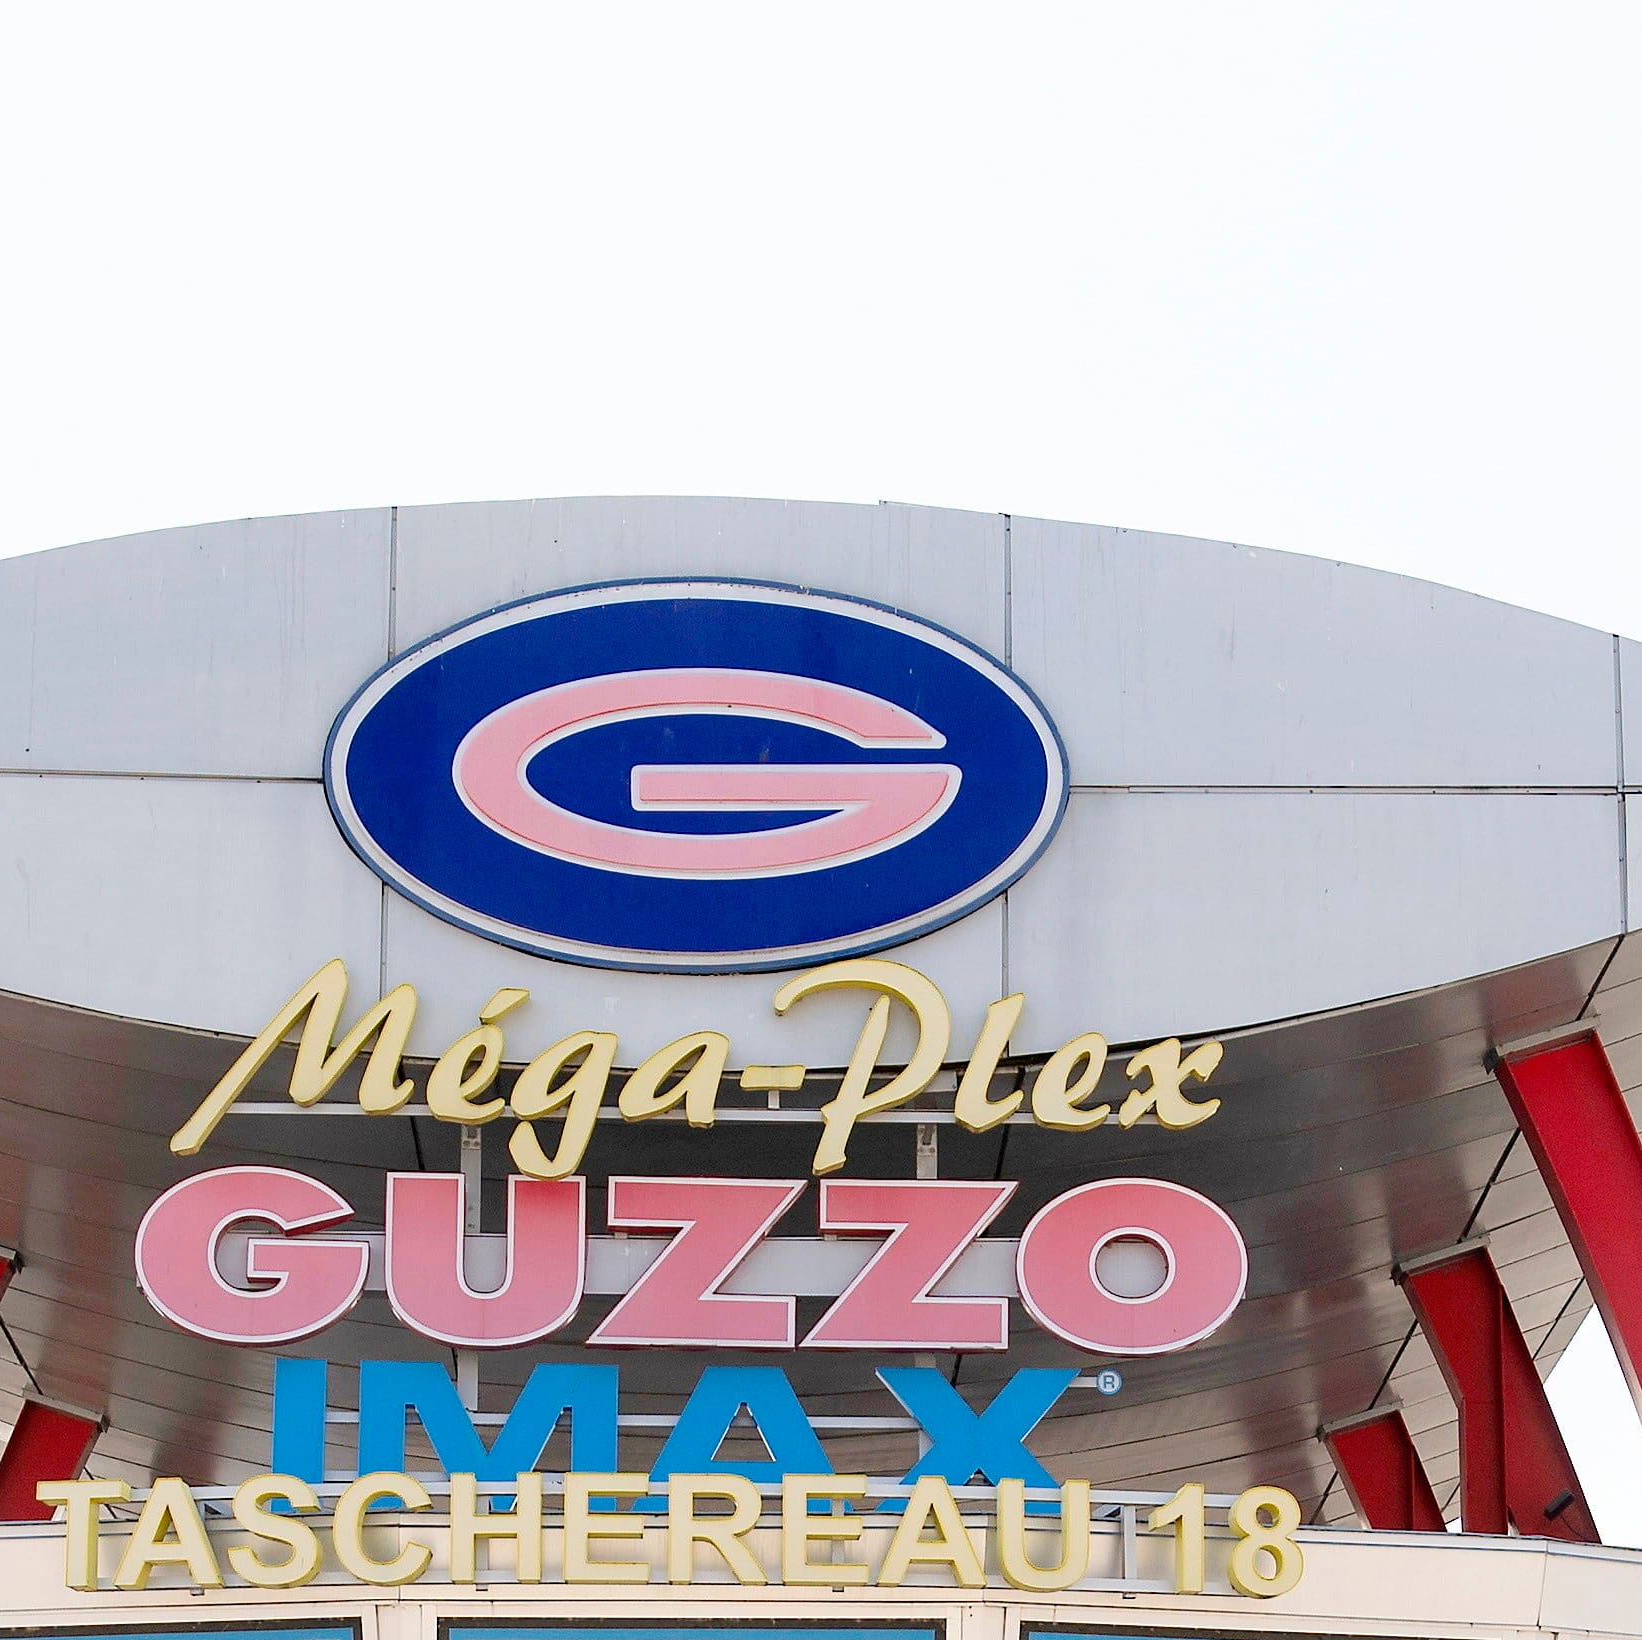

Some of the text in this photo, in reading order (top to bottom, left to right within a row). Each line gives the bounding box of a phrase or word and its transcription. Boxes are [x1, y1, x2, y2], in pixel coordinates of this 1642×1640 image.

[168, 956, 1225, 1179] Méga-Plex
[134, 1163, 1250, 1356] GUZZO
[36, 1472, 1305, 1599] TASCHEREAU 18
